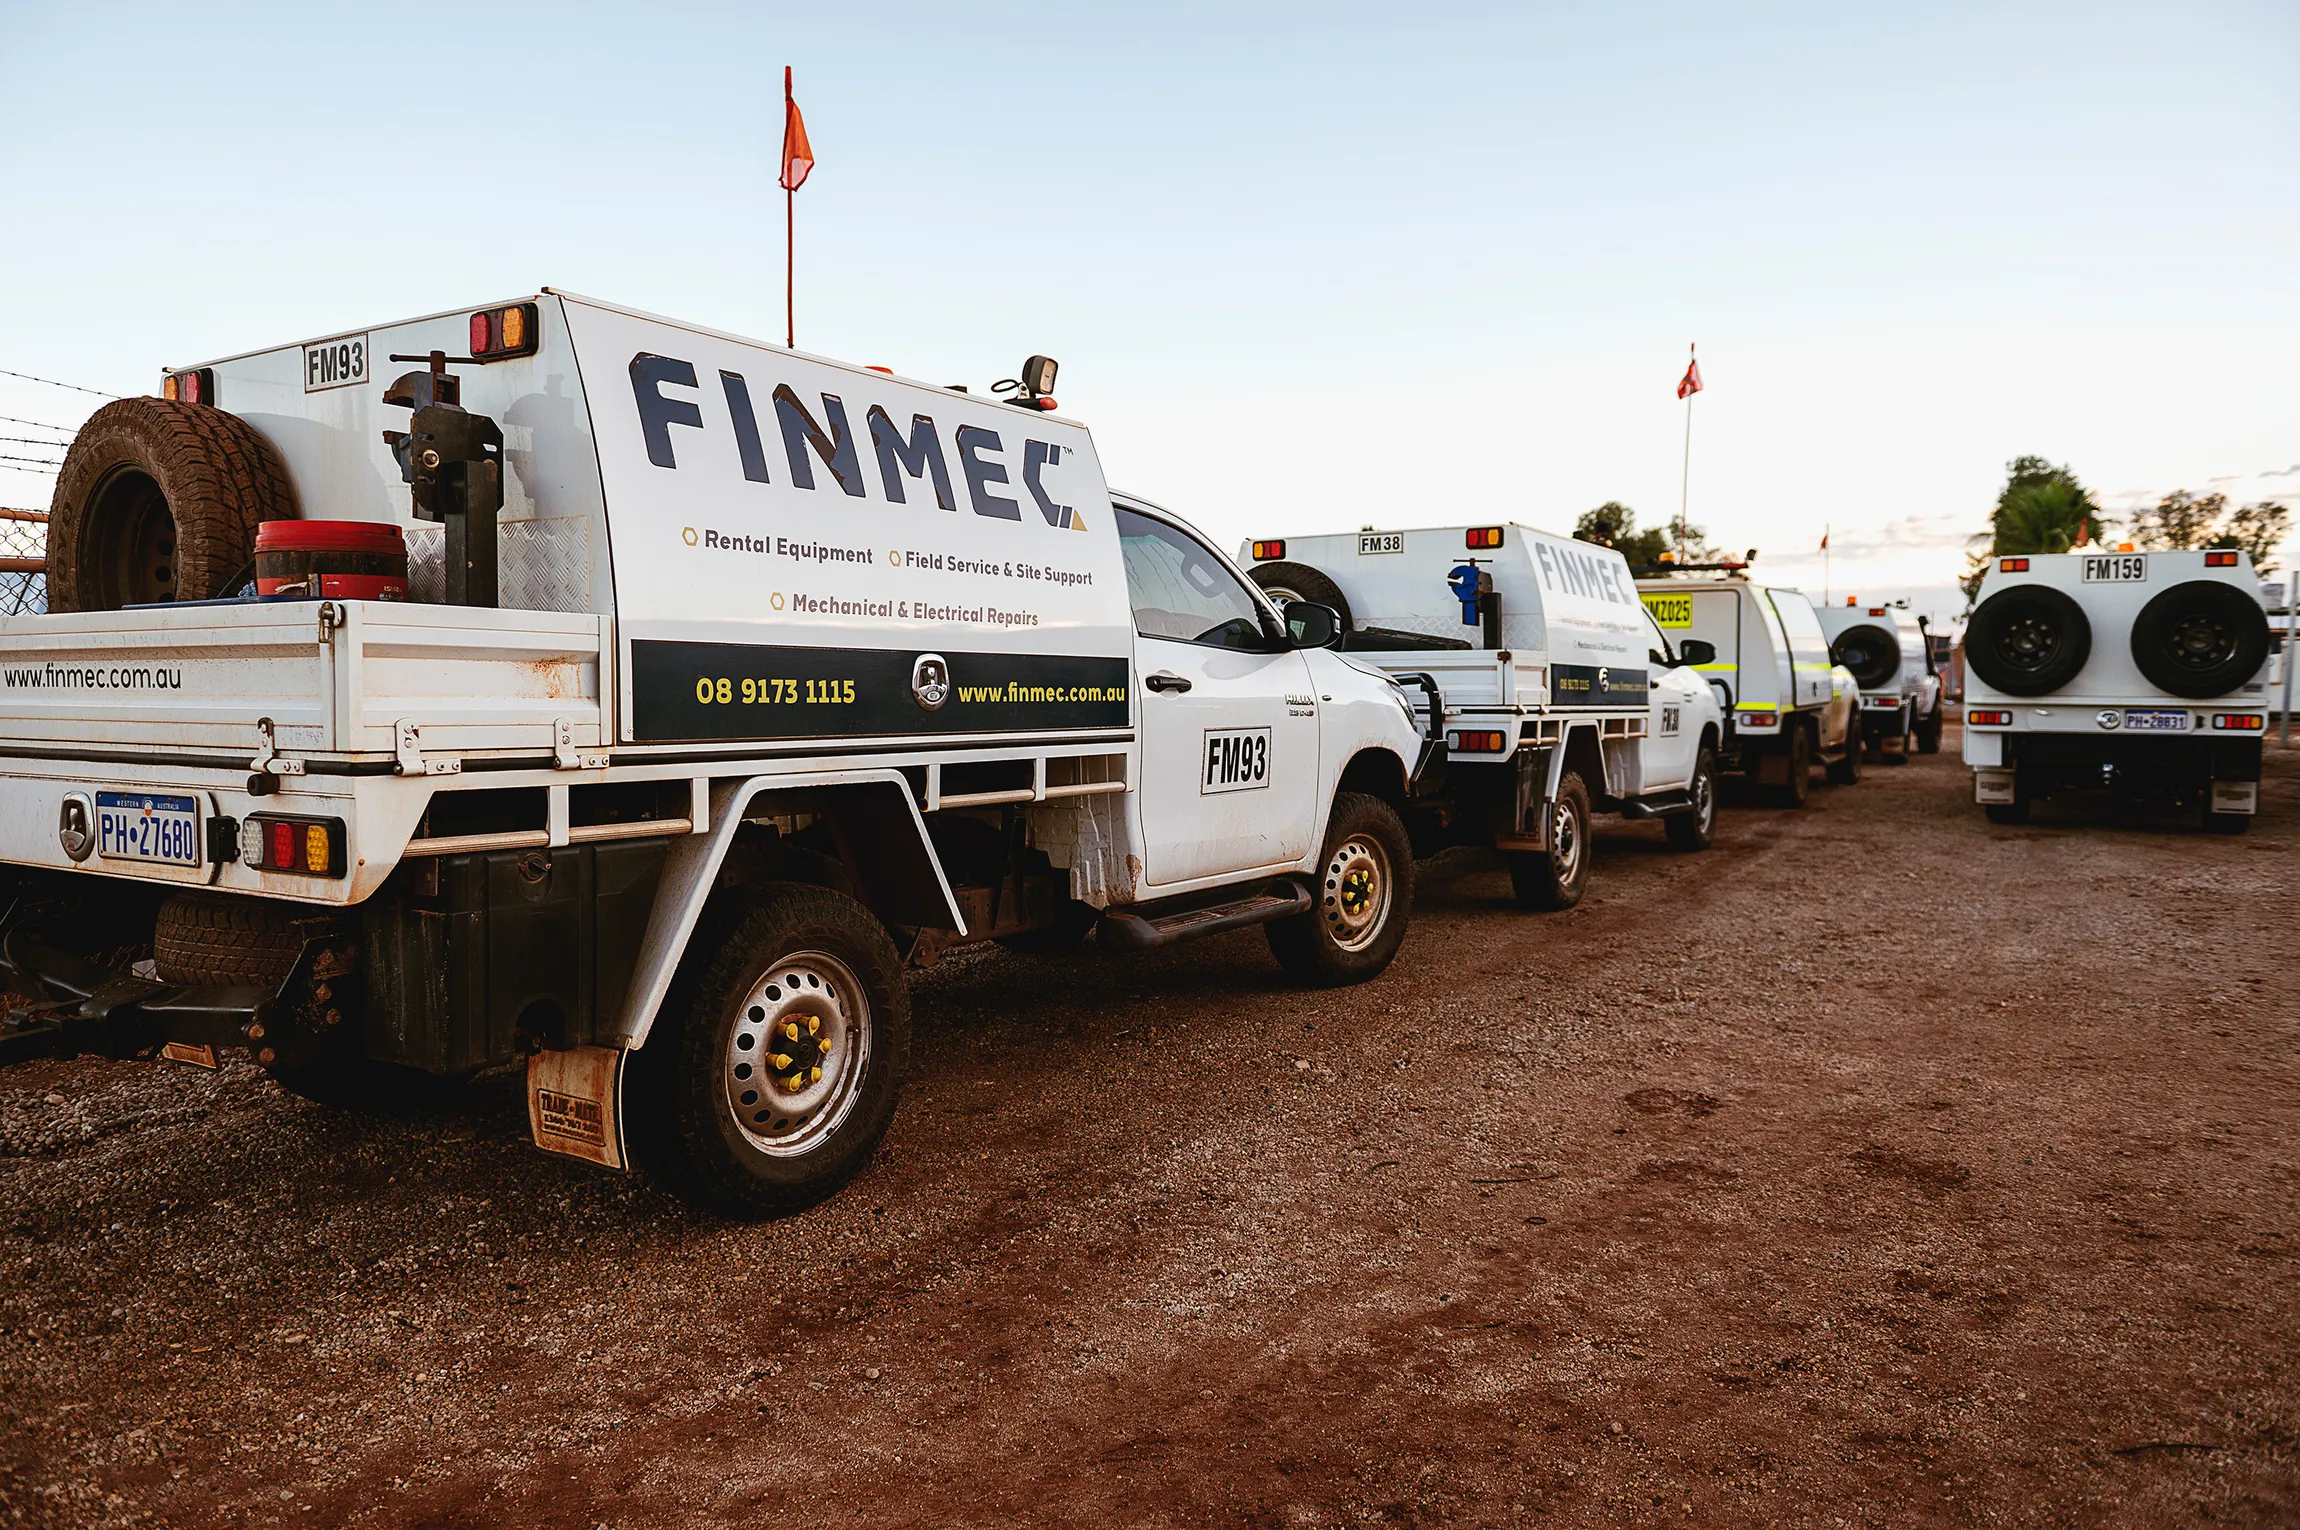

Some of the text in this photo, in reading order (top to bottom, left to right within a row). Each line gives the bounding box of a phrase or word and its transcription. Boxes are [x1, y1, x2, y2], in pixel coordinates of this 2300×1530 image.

[308, 341, 364, 385] FM93
[628, 351, 1087, 531] FINMEC
[705, 529, 873, 564] Rental Equipment
[906, 551, 1093, 587] Field Service & Site Support
[1536, 542, 1632, 605] FINMEC
[2086, 558, 2143, 579] FM159
[793, 594, 1038, 627] Mechanical & Electrical Repairs
[1643, 600, 1690, 621] MZ025
[4, 662, 182, 688] www.finmec.com.au
[696, 678, 856, 704] 08 9173 1115
[958, 682, 1125, 702] www.finmec.com.au
[1207, 735, 1266, 785] FM93
